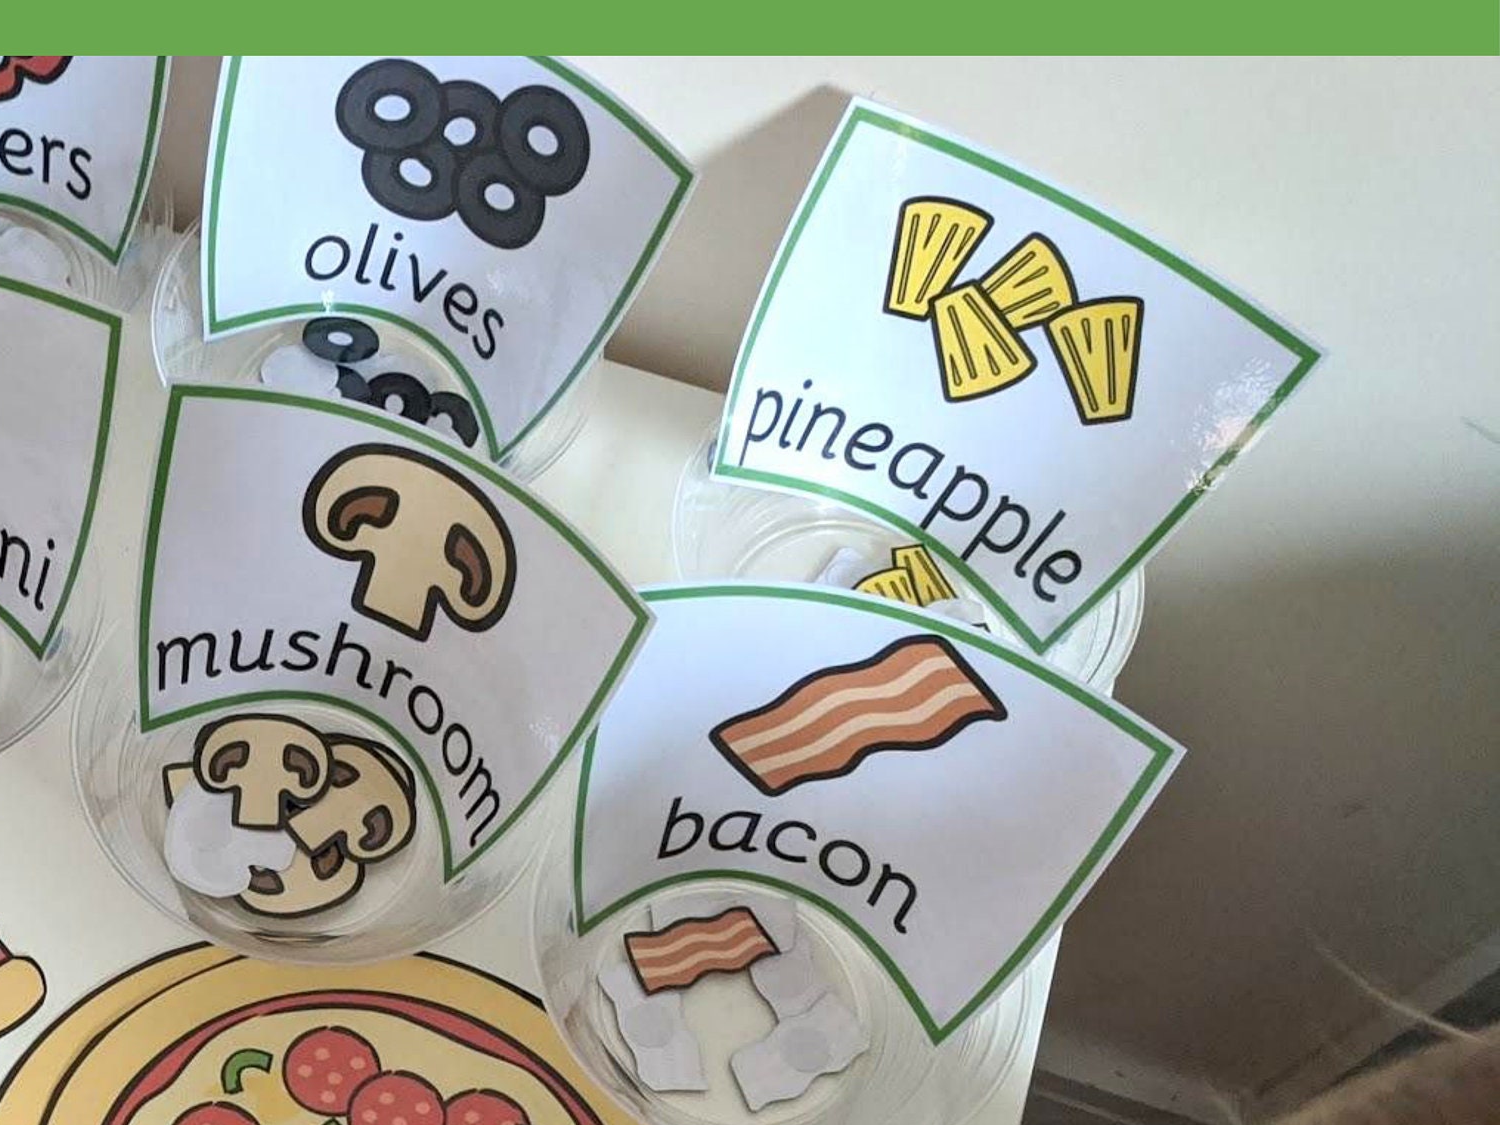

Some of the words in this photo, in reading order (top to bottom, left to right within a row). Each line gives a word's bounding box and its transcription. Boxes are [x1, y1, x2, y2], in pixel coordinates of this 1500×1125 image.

[304, 224, 504, 360] olives
[739, 379, 1083, 603] pineapple
[156, 621, 501, 846] mushroom
[659, 798, 918, 933] bacon
